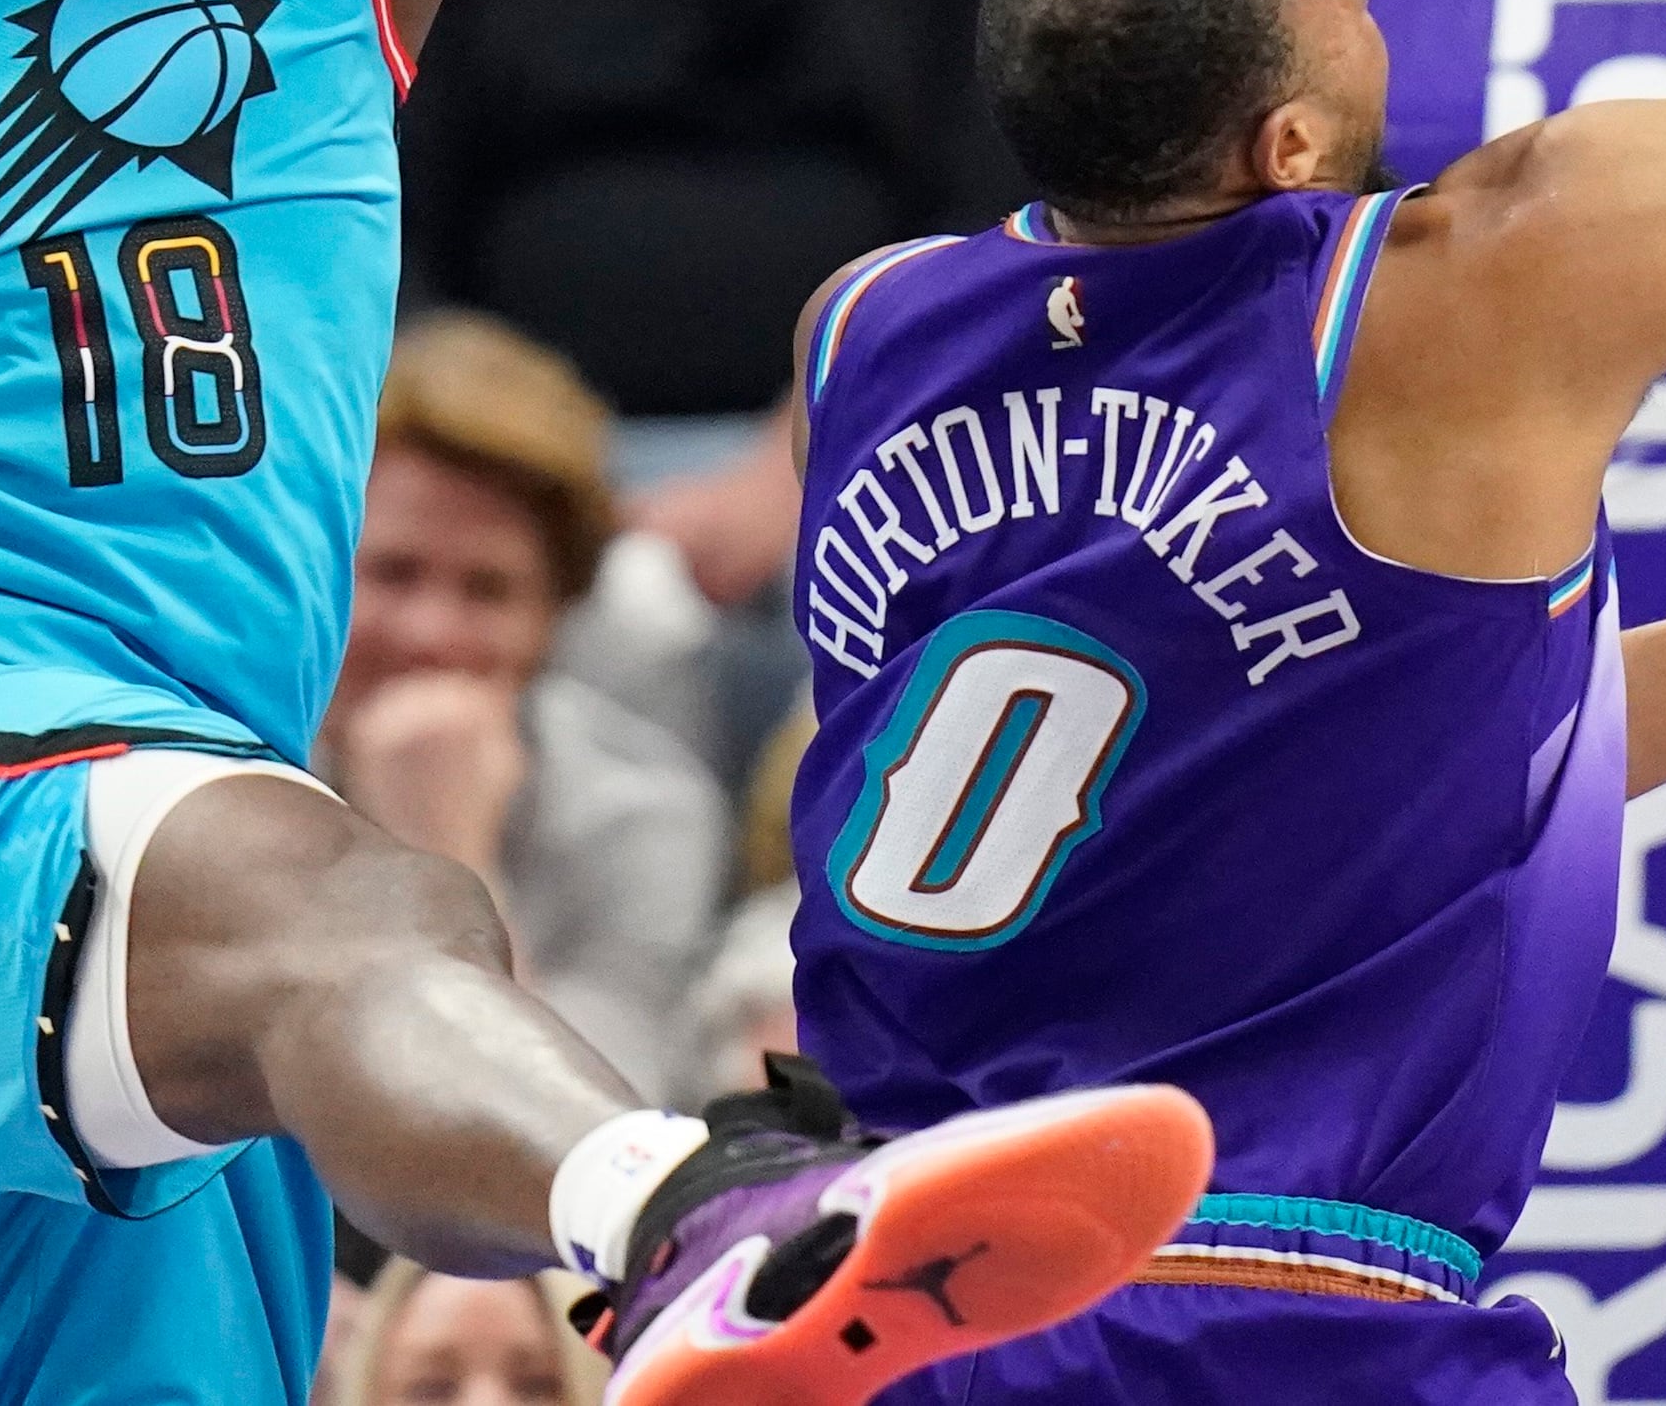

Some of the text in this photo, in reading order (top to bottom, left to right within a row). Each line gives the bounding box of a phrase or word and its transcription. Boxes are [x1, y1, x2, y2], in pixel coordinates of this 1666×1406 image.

[19, 214, 267, 488] 18
[808, 386, 1362, 686] HORTON-TUCKER
[841, 636, 1136, 941] 0
